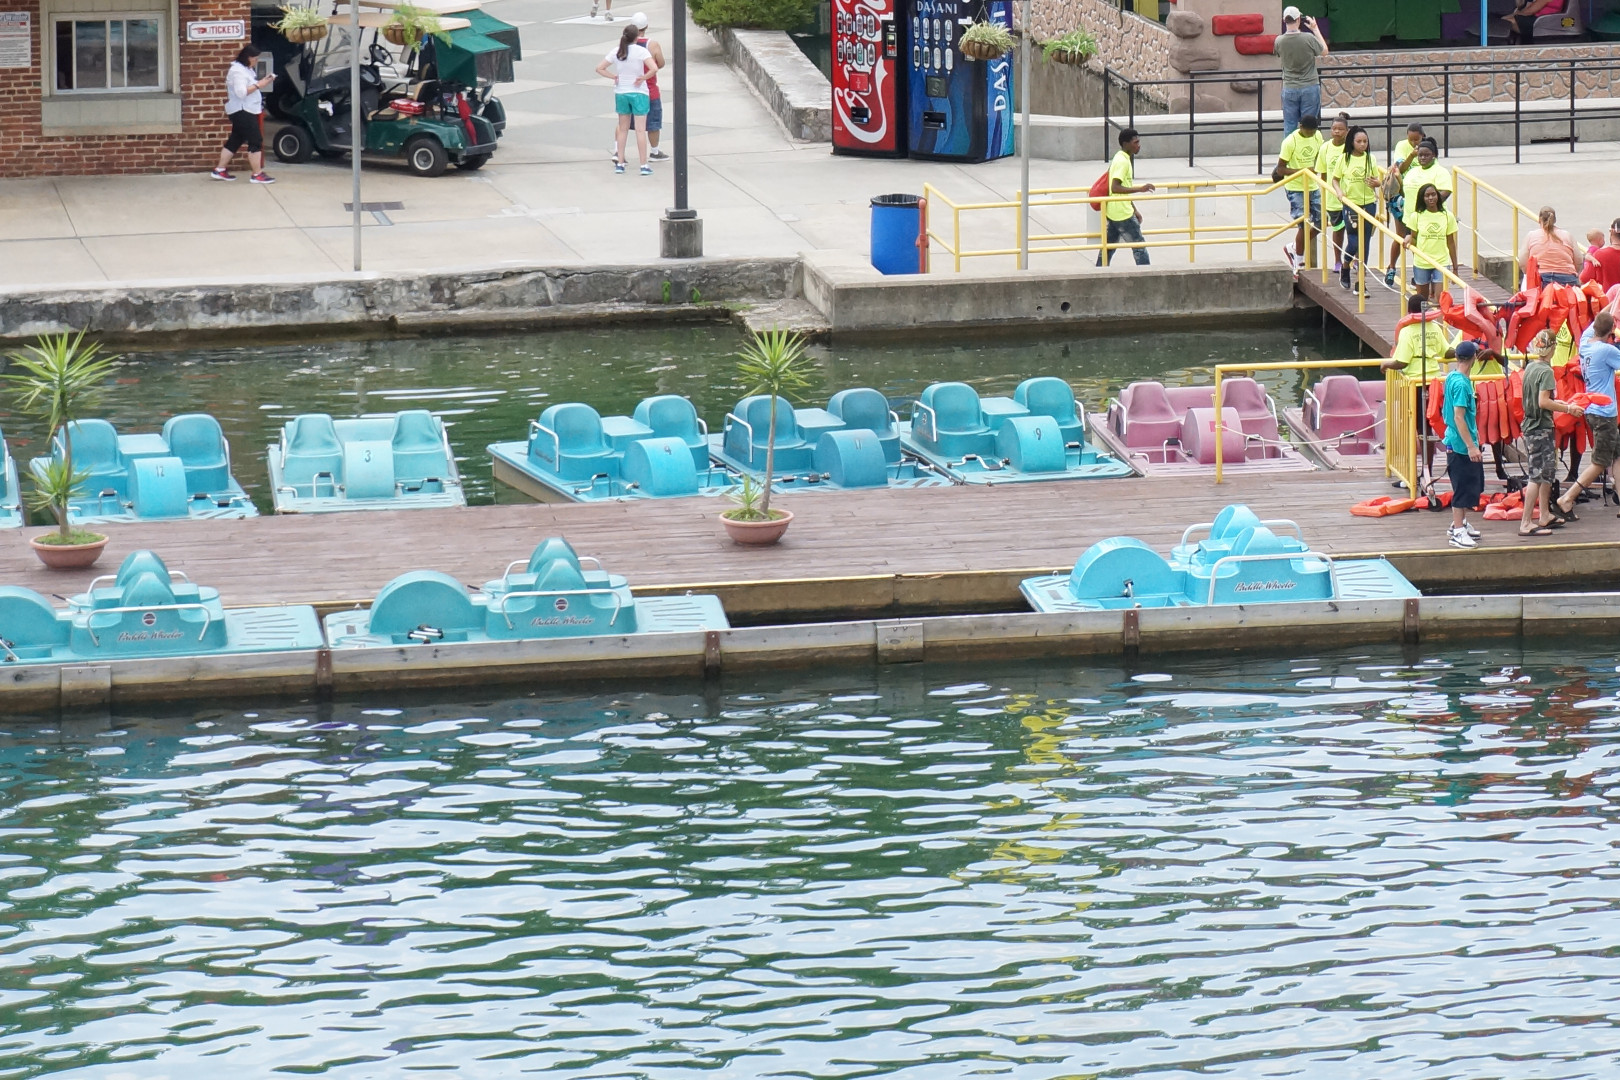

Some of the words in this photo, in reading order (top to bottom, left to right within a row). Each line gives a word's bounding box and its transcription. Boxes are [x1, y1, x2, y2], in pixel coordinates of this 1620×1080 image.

[917, 0, 958, 15] DASANI
[210, 25, 240, 35] TICKETS
[991, 11, 1010, 112] DASI
[364, 449, 372, 463] 3
